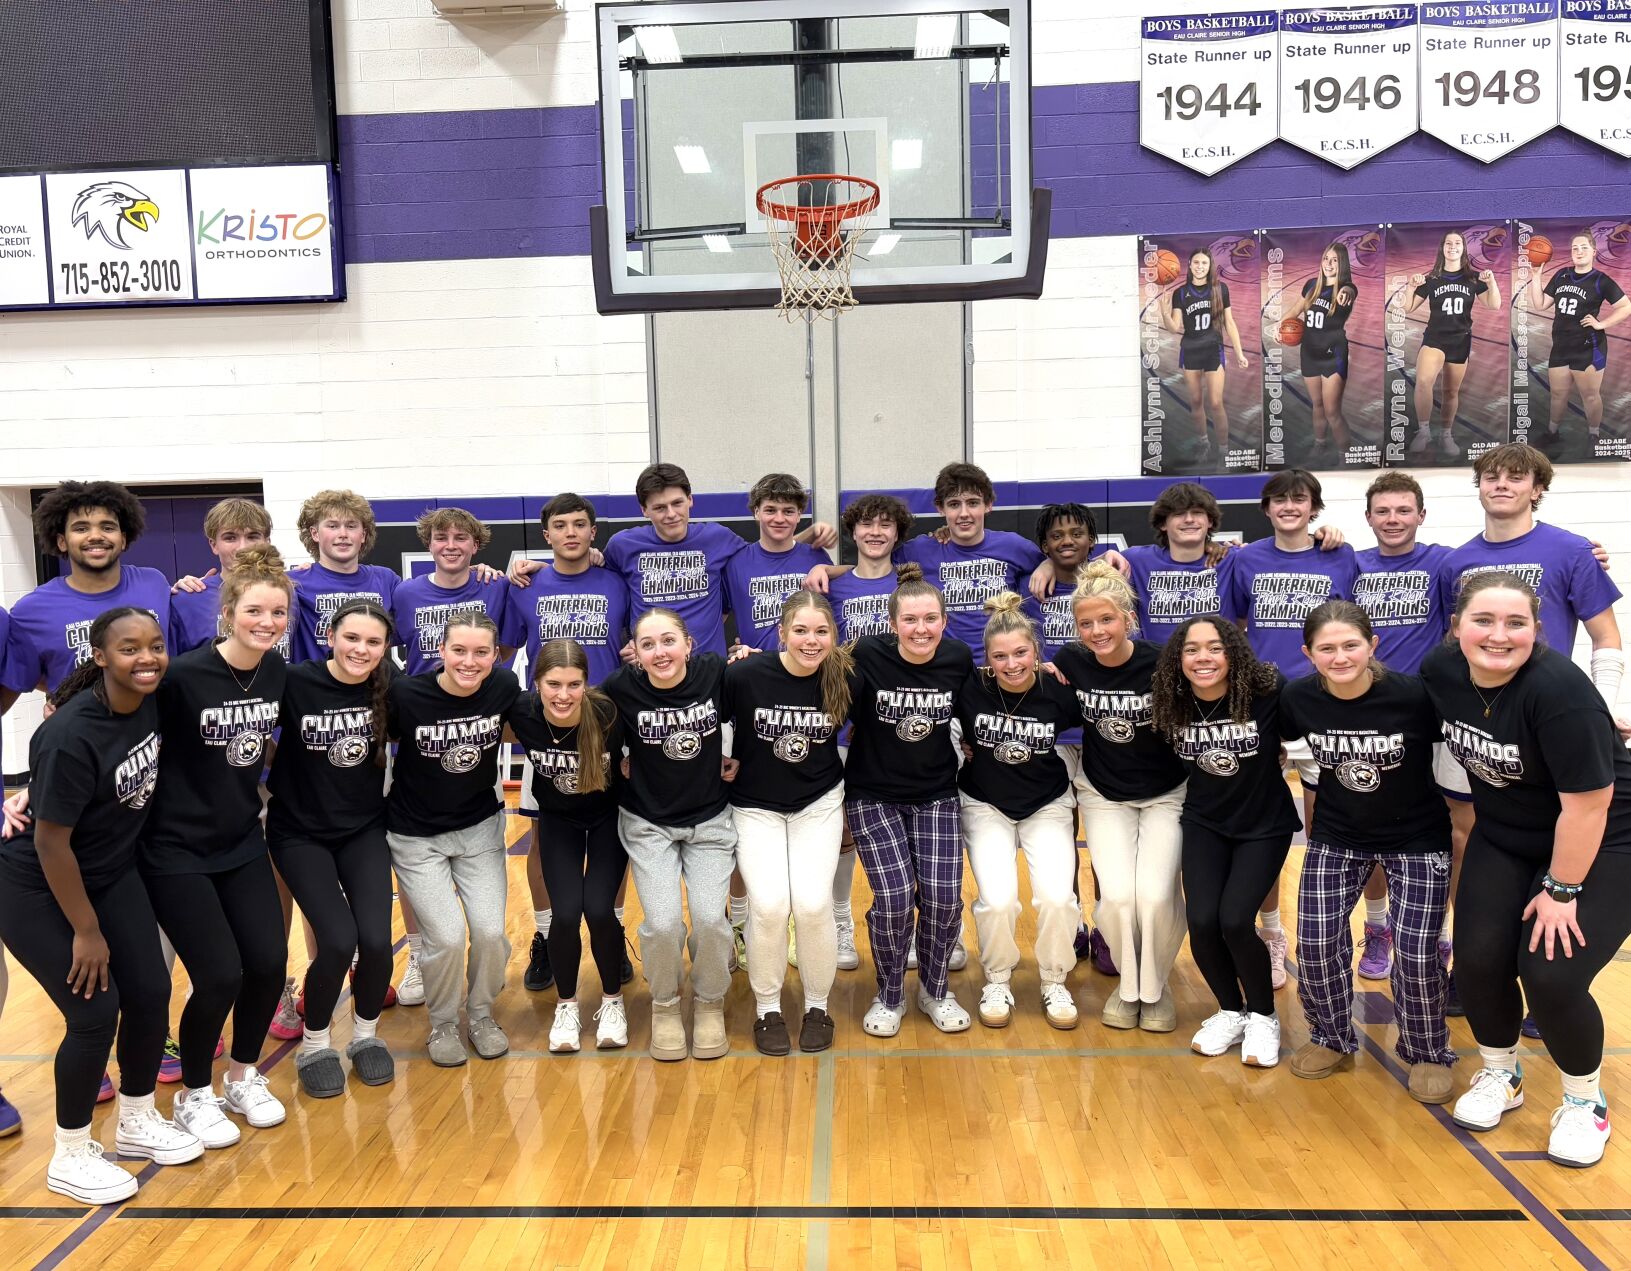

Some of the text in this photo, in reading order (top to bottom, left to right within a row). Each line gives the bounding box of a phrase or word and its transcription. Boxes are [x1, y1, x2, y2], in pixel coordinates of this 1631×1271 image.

[1426, 2, 1553, 18] BOYS BASKETBALL
[1566, 0, 1602, 12] BOYS
[1147, 15, 1274, 32] BOYS BASKETBALL
[1285, 7, 1413, 25] BOYS BASKETBALL
[1425, 35, 1551, 51] State Runner up
[1566, 33, 1608, 46] State
[1147, 49, 1272, 65] State Runner up
[1286, 41, 1411, 58] State Runner up
[1434, 68, 1541, 107] 1948
[1574, 65, 1631, 102] 19
[1156, 81, 1262, 121] 1944
[1294, 74, 1402, 113] 1946
[1320, 138, 1375, 151] E.C.S.H.
[1460, 132, 1515, 145] E.C.S.H.
[1181, 146, 1235, 159] E.C.S.H.
[0, 225, 28, 234] ROYAL
[205, 247, 321, 260] ORTHODONTICS
[61, 259, 181, 295] 715-852-3010
[1434, 283, 1471, 298] MEMORIAL
[1555, 284, 1587, 300] MEMORIAL
[1186, 300, 1211, 316] MEMORI
[1441, 297, 1464, 315] 40
[1558, 297, 1578, 316] 42
[1194, 313, 1211, 331] 10
[1306, 310, 1325, 329] 30
[1141, 240, 1165, 472] Ashlynn Schroeder
[1264, 247, 1285, 464] Meredith Adams
[1386, 275, 1409, 461] Rayna Welsch
[1513, 392, 1532, 445] bigail
[1225, 454, 1260, 462] Basketball
[1344, 450, 1381, 458] Basketball
[638, 554, 706, 572] CONFERENCE
[940, 562, 1008, 581] CONFERENCE
[641, 573, 708, 595] CHAMPIONS
[749, 578, 802, 597] CONFEREN
[1147, 573, 1218, 591] CONFERENCE
[1252, 578, 1332, 596] CONFERENCE
[536, 598, 608, 616] CONFERENCE
[842, 599, 888, 619] CONFERE
[1148, 596, 1220, 615] CHAMPIONS
[1254, 603, 1313, 620] CHAMPIO
[539, 622, 609, 639] CHAMPIONS
[845, 622, 890, 641] CHAMPI
[876, 690, 953, 719] CHAMPS
[1076, 689, 1153, 722] CHAMPS
[200, 701, 280, 739] CHAMPS
[301, 709, 374, 745] CHAMP
[637, 698, 718, 738] CHAMPS
[754, 707, 834, 739] CHAMPS
[415, 714, 501, 753] CHAMPS
[974, 713, 1055, 750] CHAMPS
[1308, 732, 1405, 765] CHAMPS
[1441, 719, 1524, 775] CHAMPS
[115, 735, 159, 798] CHAM
[530, 749, 581, 775] CHAM
